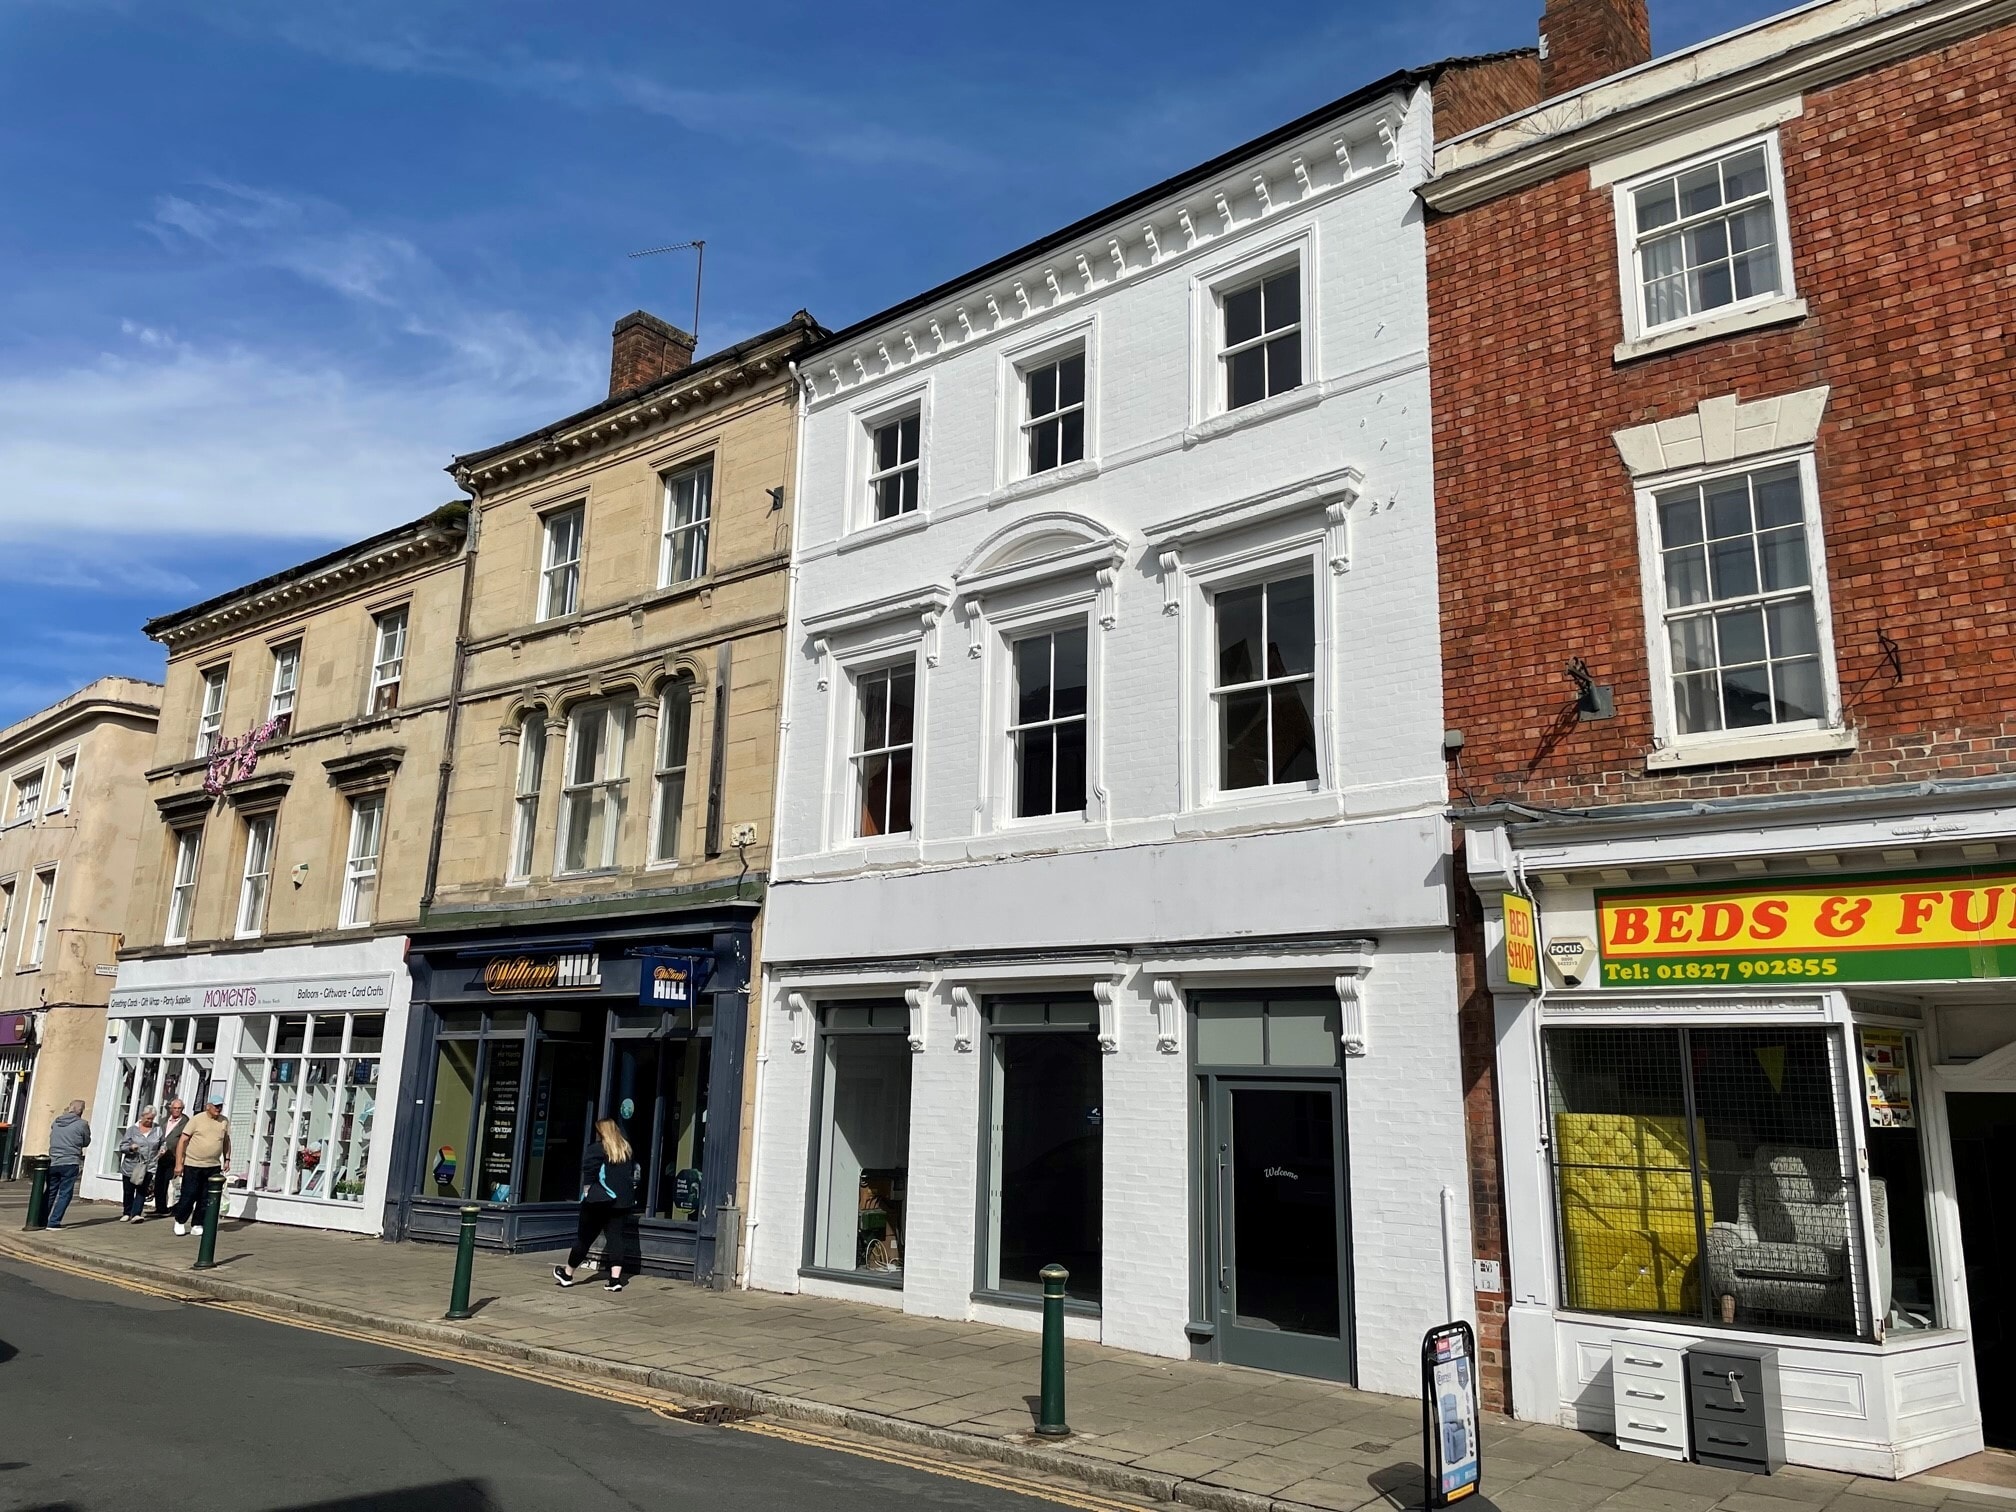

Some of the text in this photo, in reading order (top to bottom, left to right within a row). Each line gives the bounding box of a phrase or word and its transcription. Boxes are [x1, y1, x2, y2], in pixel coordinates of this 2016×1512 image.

[1509, 908, 1529, 938] BED
[1609, 900, 1788, 945] BEDS
[1814, 896, 1873, 937] &
[1508, 941, 1534, 971] SHOP
[1551, 944, 1582, 953] FOCUS
[485, 953, 602, 990] William HILL
[653, 966, 688, 981] William
[1604, 958, 1837, 981] Tel: 01827 902855
[297, 985, 384, 999] Balloons Giftware Card Crafts
[653, 980, 687, 1000] HILL
[1264, 1166, 1298, 1180] Welcome
